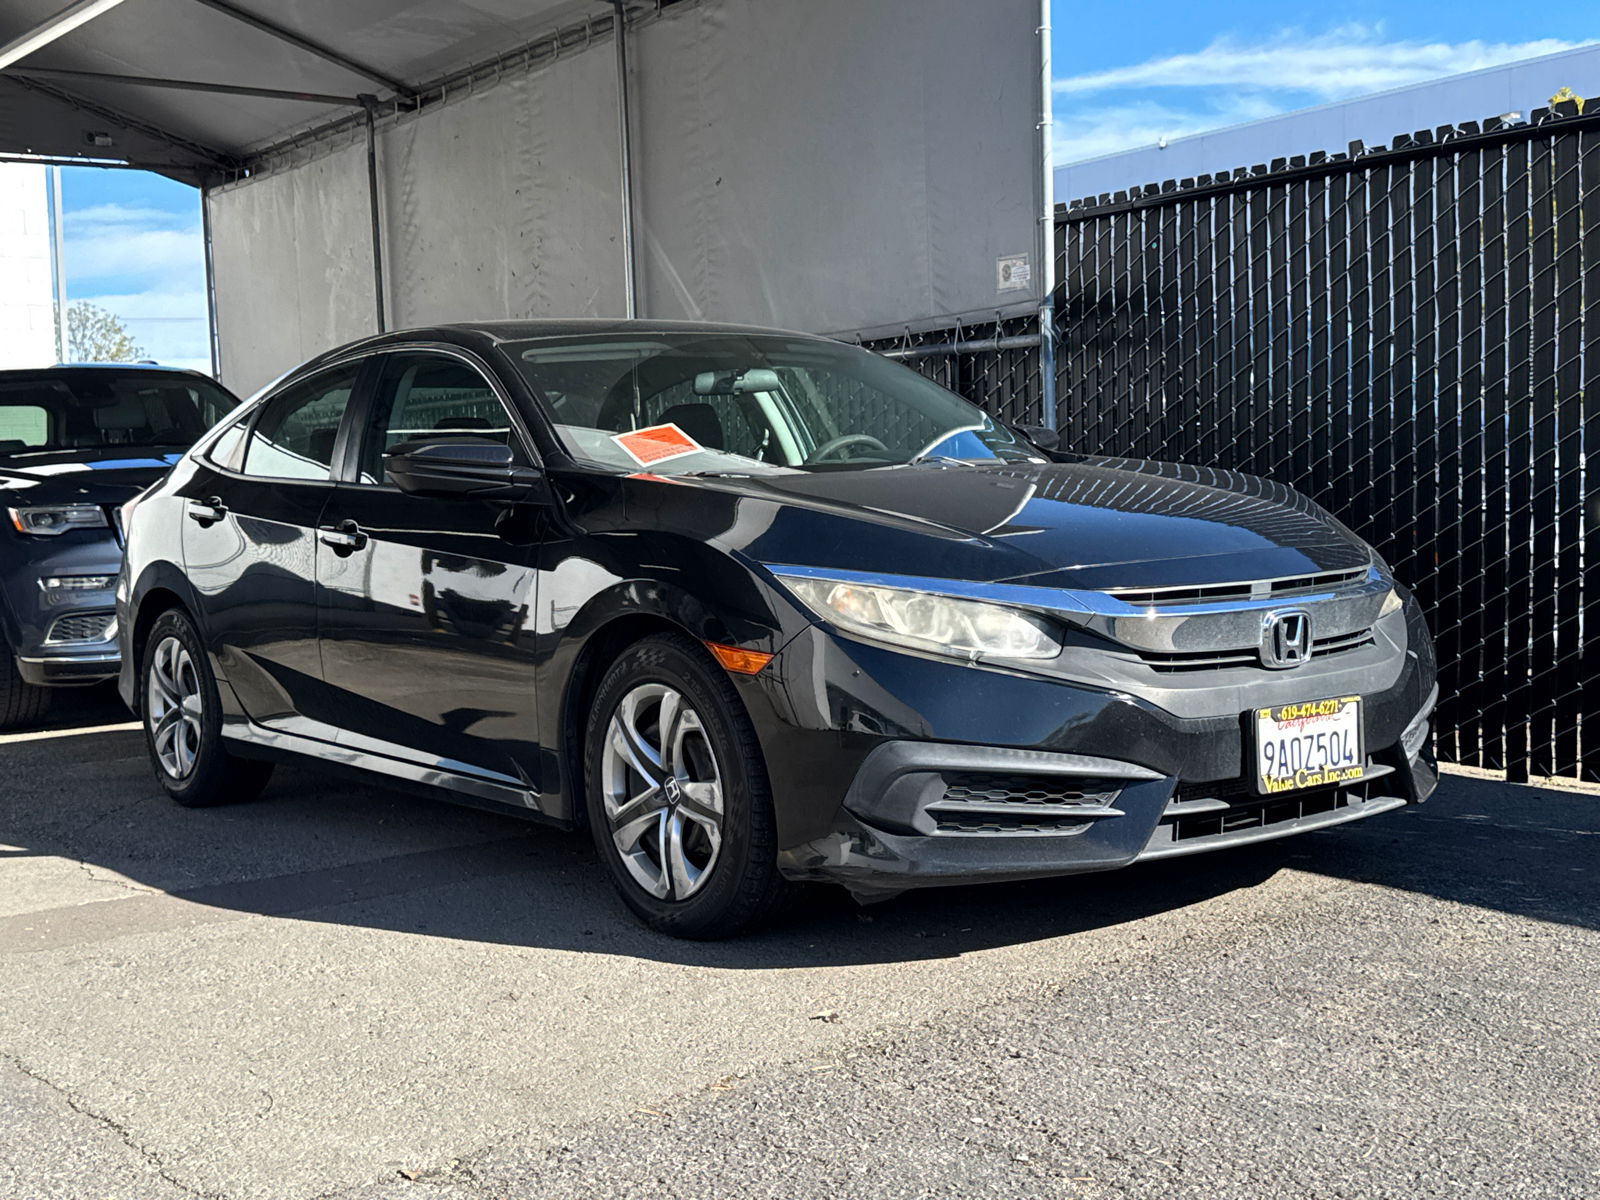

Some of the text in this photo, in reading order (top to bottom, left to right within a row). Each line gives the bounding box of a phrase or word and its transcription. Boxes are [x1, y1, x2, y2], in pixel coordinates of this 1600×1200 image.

[1281, 699, 1340, 721] 619-474-6271
[1261, 773, 1294, 793] Value
[1295, 768, 1322, 788] Cars
